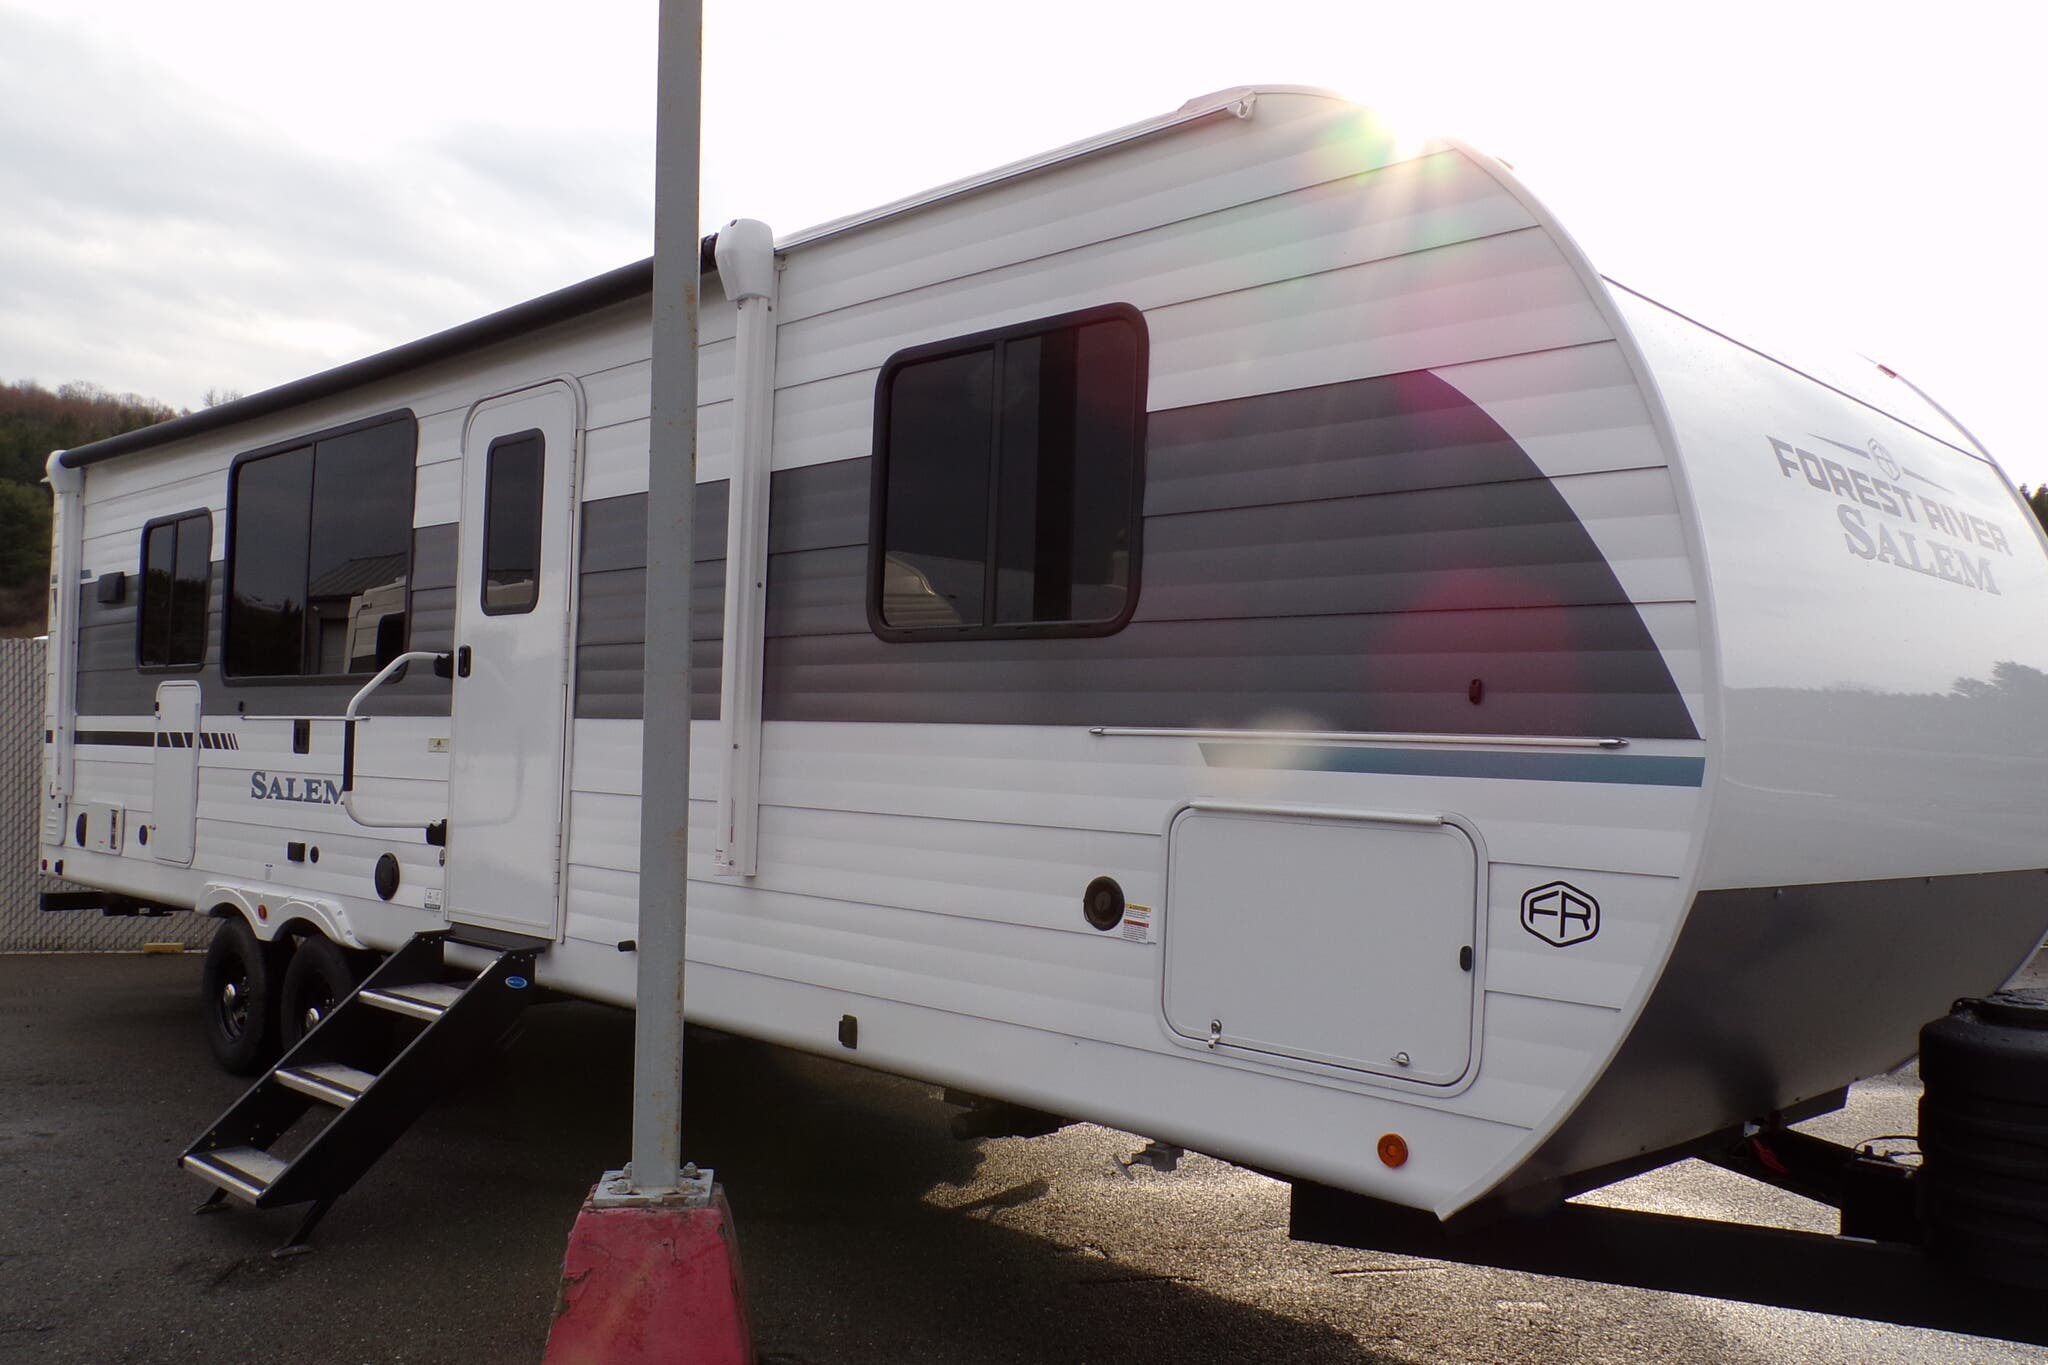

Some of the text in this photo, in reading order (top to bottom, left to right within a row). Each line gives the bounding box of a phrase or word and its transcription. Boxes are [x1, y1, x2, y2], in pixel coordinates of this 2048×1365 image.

[1766, 435, 2014, 557] FOREST RIVER
[1837, 504, 2002, 596] SALEM
[251, 771, 344, 805] SALEM
[1529, 889, 1591, 938] FR
